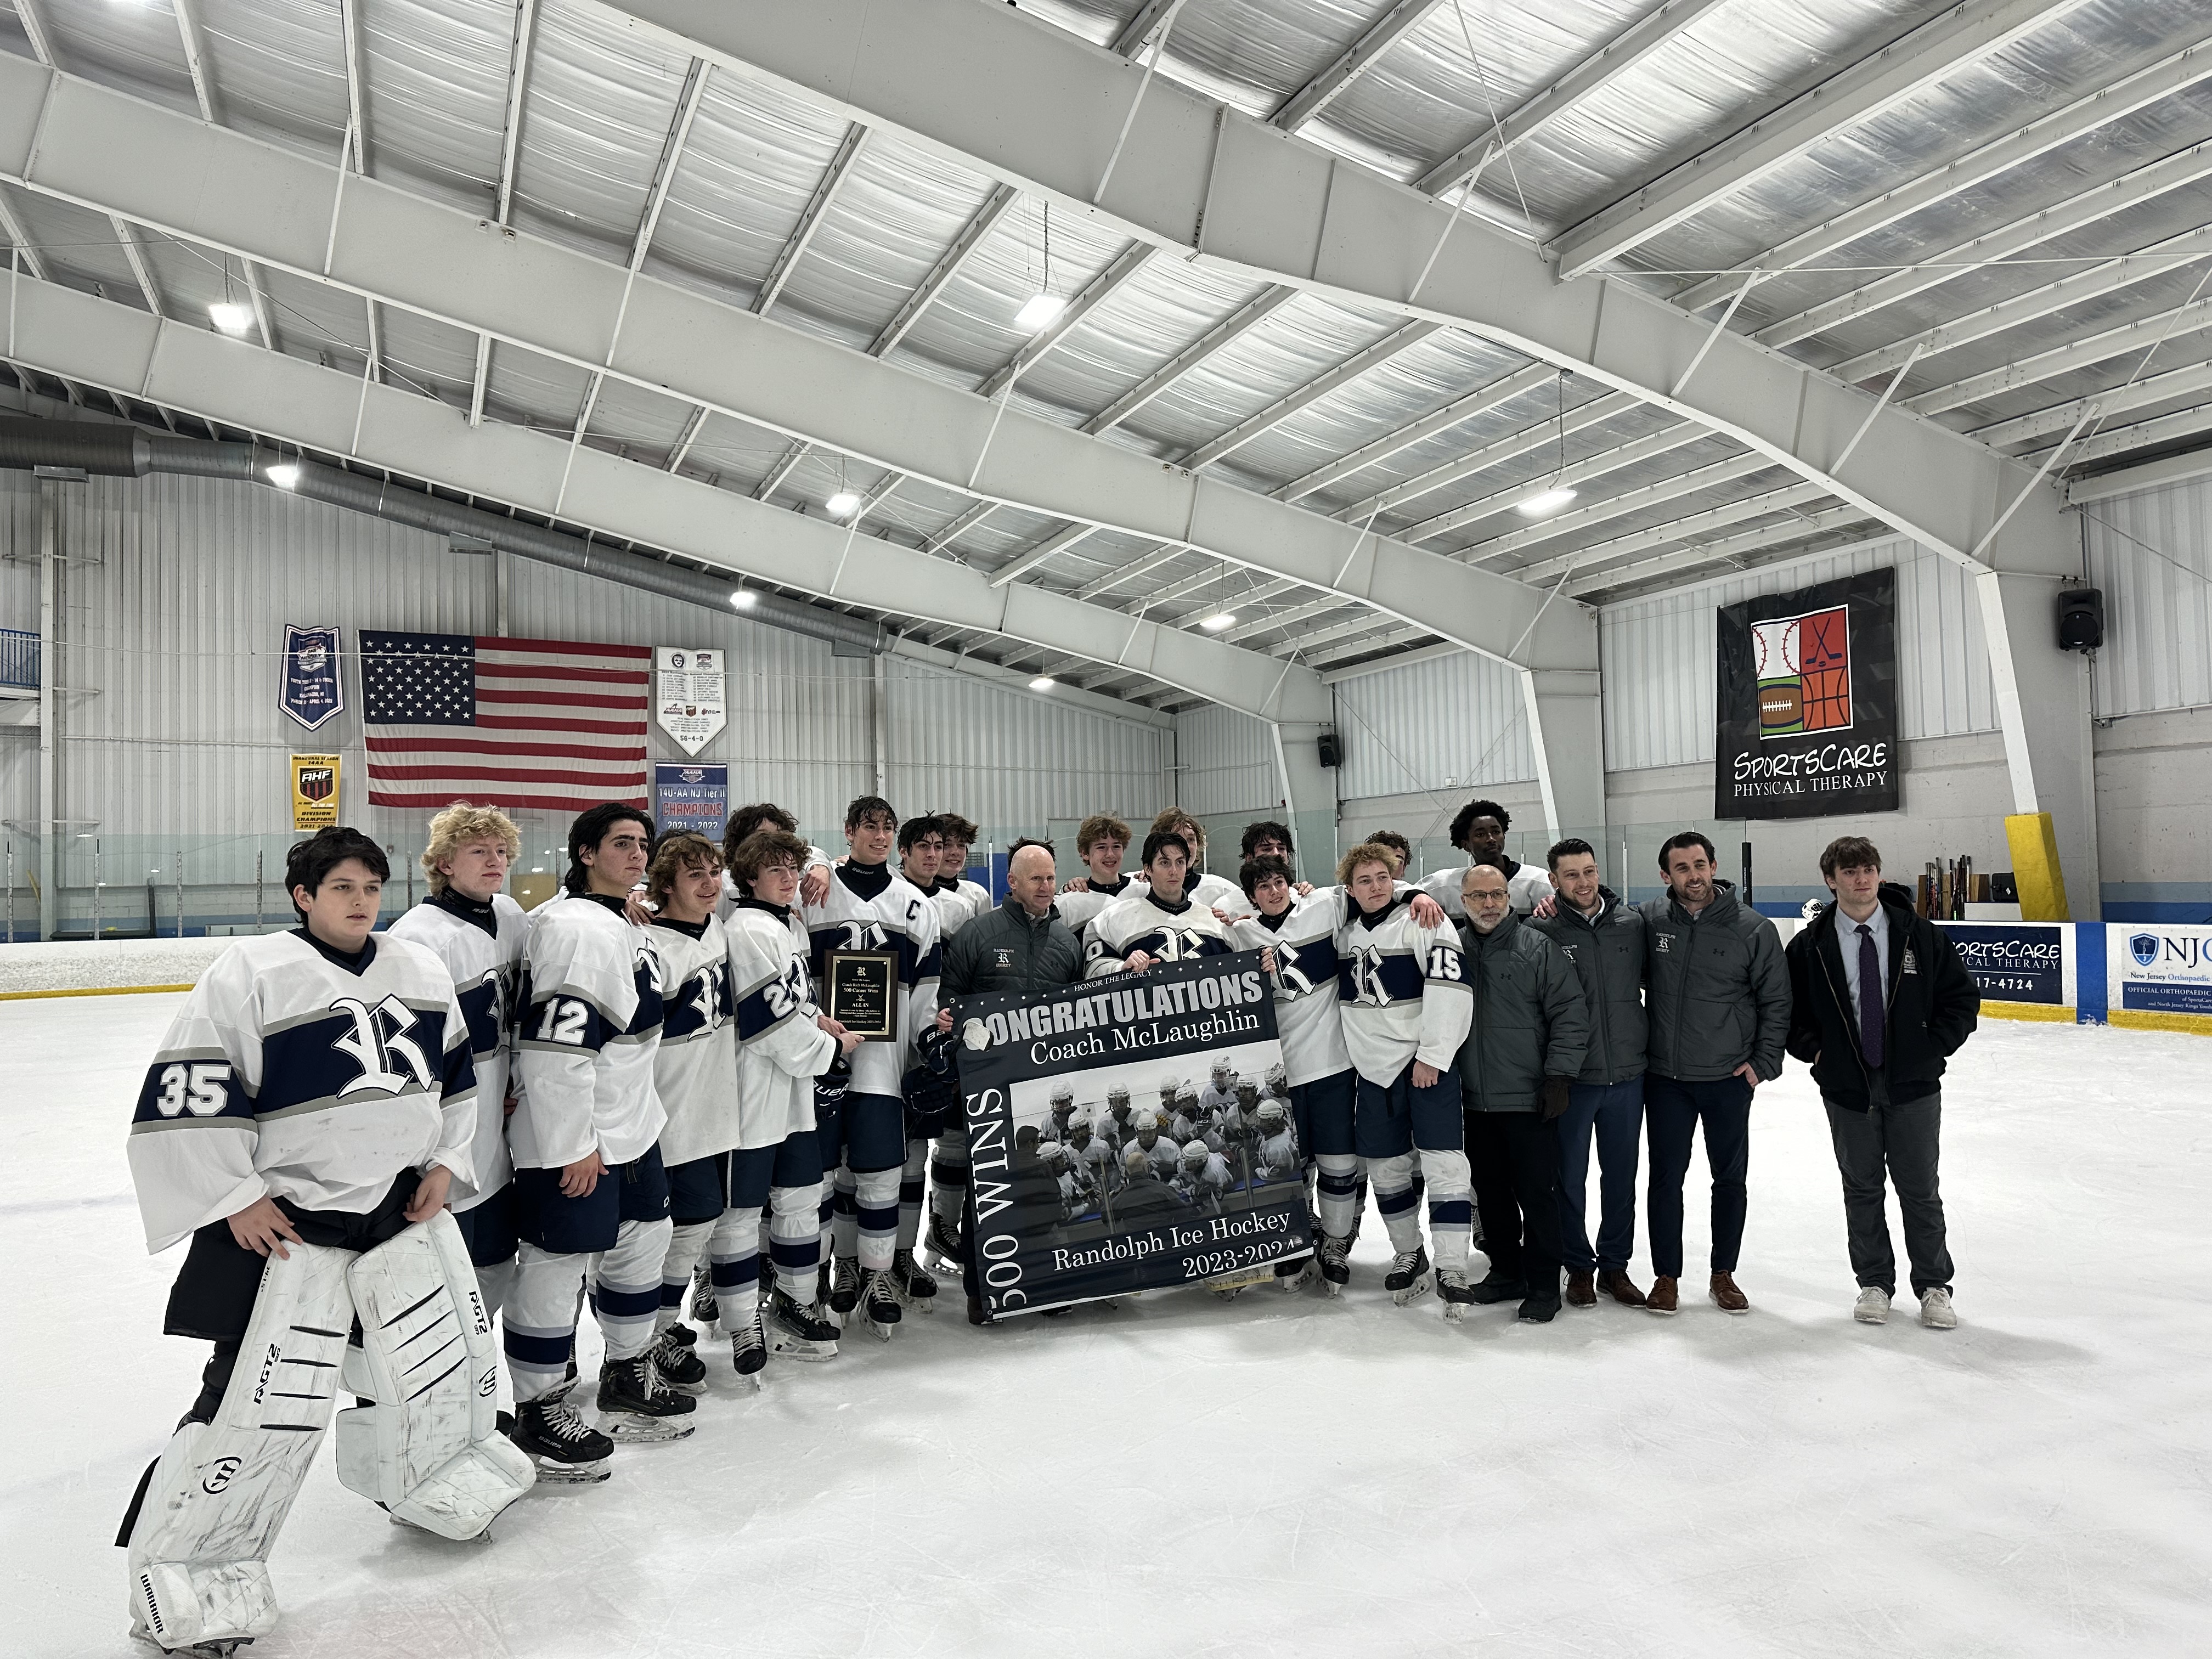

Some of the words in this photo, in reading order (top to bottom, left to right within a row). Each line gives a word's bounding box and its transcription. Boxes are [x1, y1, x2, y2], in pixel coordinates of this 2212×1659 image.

[302, 770, 331, 783] AHF
[1734, 779, 1805, 797] PHYSICAL
[1810, 770, 1888, 793] THERAPY
[659, 787, 688, 798] 14U-AA
[690, 788, 701, 798] NJ
[703, 788, 717, 798] Tier
[663, 802, 723, 816] CHAMPIONS
[667, 821, 687, 830] 2021
[697, 821, 718, 830] 2022
[906, 899, 922, 922] C
[1657, 937, 1668, 949] R
[997, 952, 1009, 963] R
[1430, 947, 1462, 981] 15
[1996, 958, 2058, 969] THERAPY
[856, 967, 866, 976] R
[1074, 980, 1103, 992] HONOR
[1104, 974, 1120, 985] THE
[1121, 969, 1153, 981] LEGACY
[1348, 943, 1395, 1008] R
[2147, 973, 2166, 981] Jersey
[2168, 973, 2210, 983] Orthopaedic
[2160, 988, 2212, 996] ORTHOPAEDIC
[536, 997, 589, 1045] 12
[329, 993, 435, 1099] R
[1030, 1035, 1106, 1065] Coach
[1113, 1009, 1260, 1052] McLaughlin
[157, 1063, 232, 1117] 35
[966, 1087, 1014, 1225] WINS
[1052, 1232, 1164, 1272] Randolph
[1169, 1225, 1204, 1248] Ice
[1208, 1211, 1291, 1242] Hockey
[140, 1573, 163, 1634] WARRIOR
